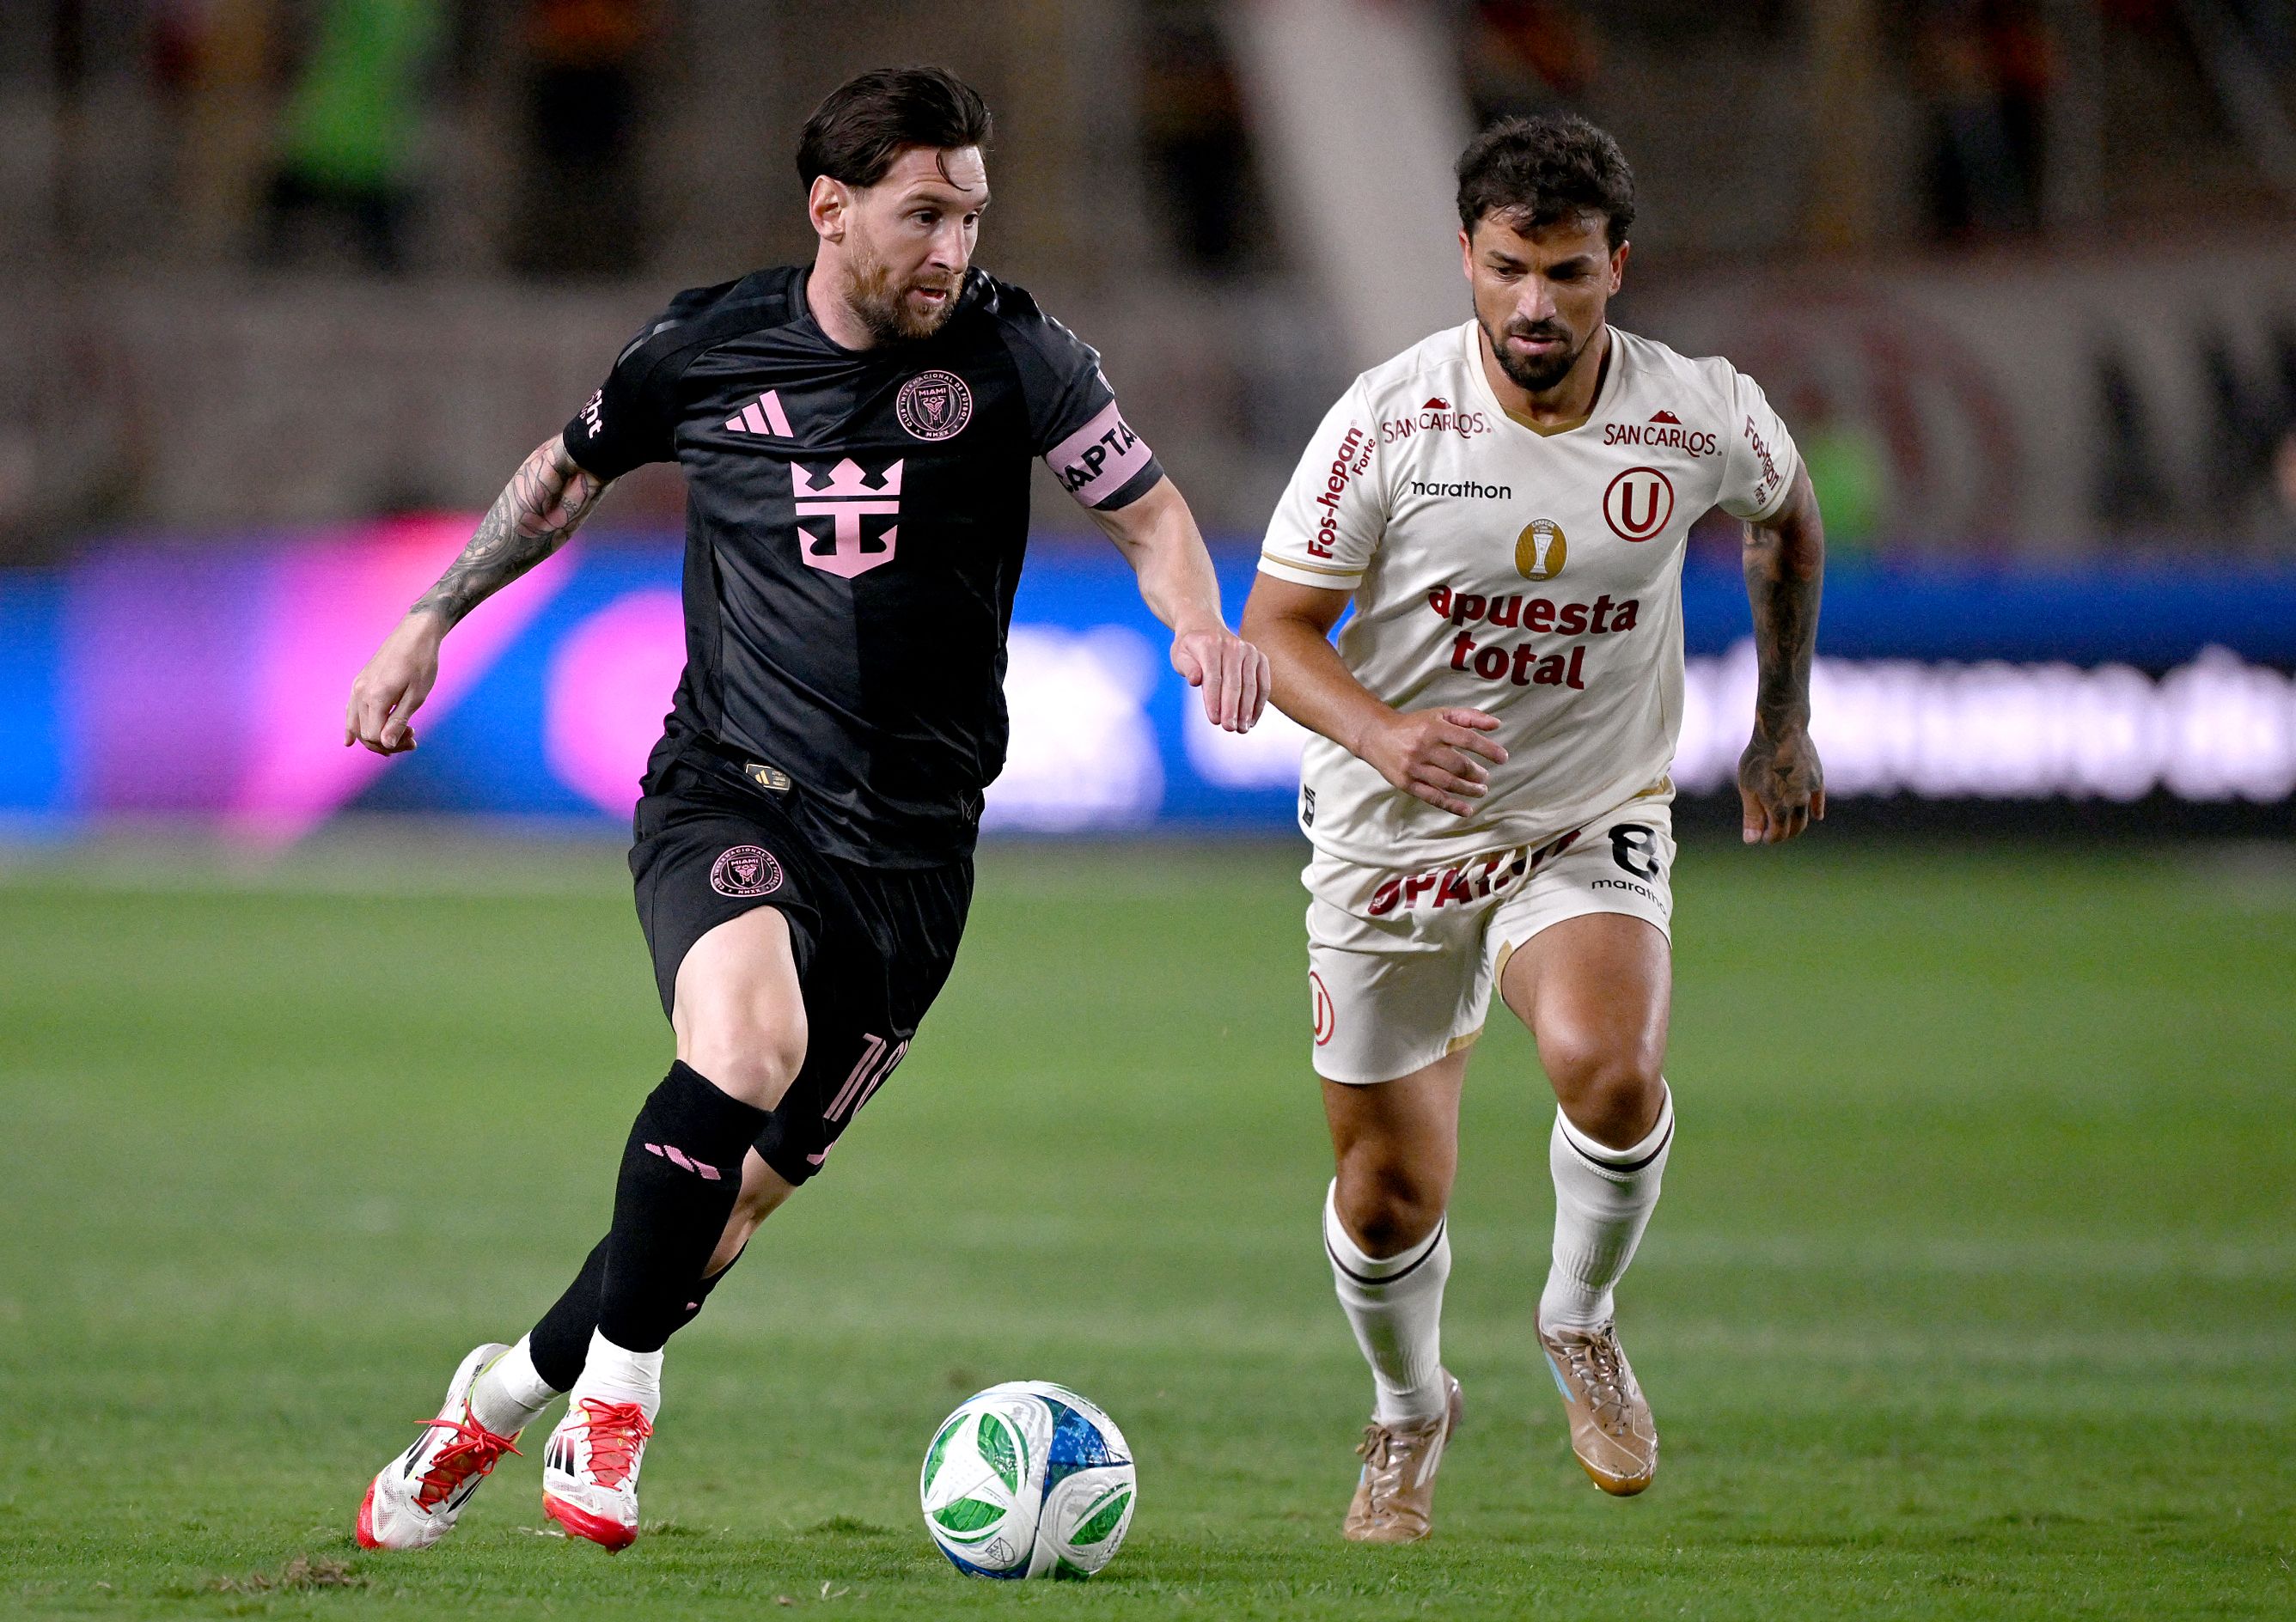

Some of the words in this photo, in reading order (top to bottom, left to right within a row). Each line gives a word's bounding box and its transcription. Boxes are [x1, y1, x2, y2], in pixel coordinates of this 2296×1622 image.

[918, 387, 947, 396] MIAMI
[901, 408, 913, 427] CLUB
[925, 430, 950, 438] MMXX
[1382, 418, 1417, 444] SAN
[1419, 412, 1485, 440] CARLOS
[1352, 437, 1377, 477] Forte
[1603, 423, 1641, 446] SAN
[1643, 426, 1717, 458] CARLOS
[1307, 426, 1365, 559] Fos-hepan
[1621, 481, 1660, 534] U
[1428, 584, 1640, 637] apuesta
[1450, 631, 1586, 691] total
[730, 858, 759, 867] MIAMI
[1608, 823, 1660, 885] 8
